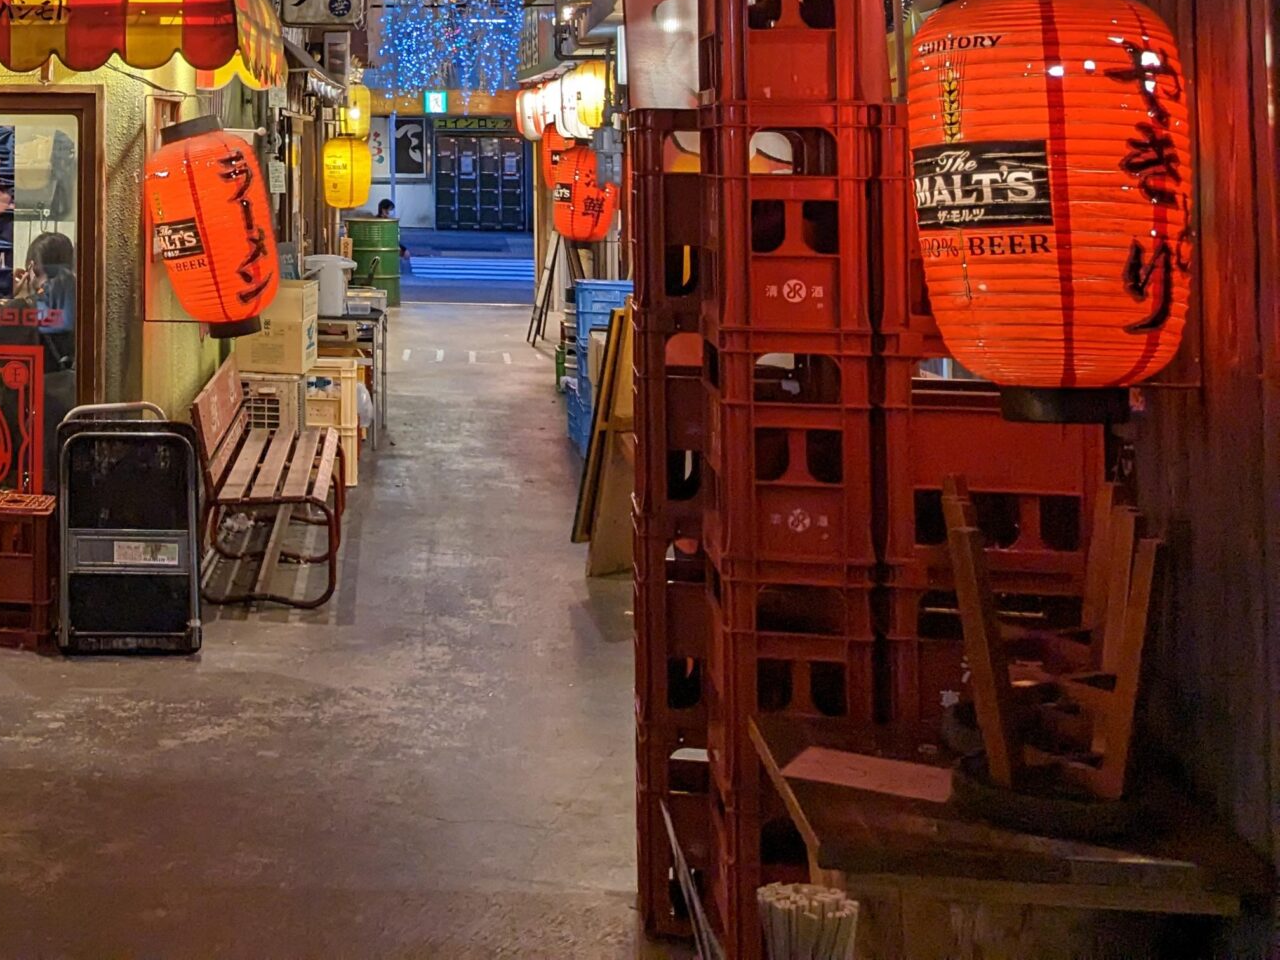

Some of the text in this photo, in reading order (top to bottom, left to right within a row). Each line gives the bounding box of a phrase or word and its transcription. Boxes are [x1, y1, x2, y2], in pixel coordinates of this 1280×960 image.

[935, 150, 978, 174] The
[914, 170, 1037, 209] MALT'S
[217, 150, 273, 304] ラーメン
[968, 233, 1052, 257] BEER
[175, 257, 208, 272] BEER
